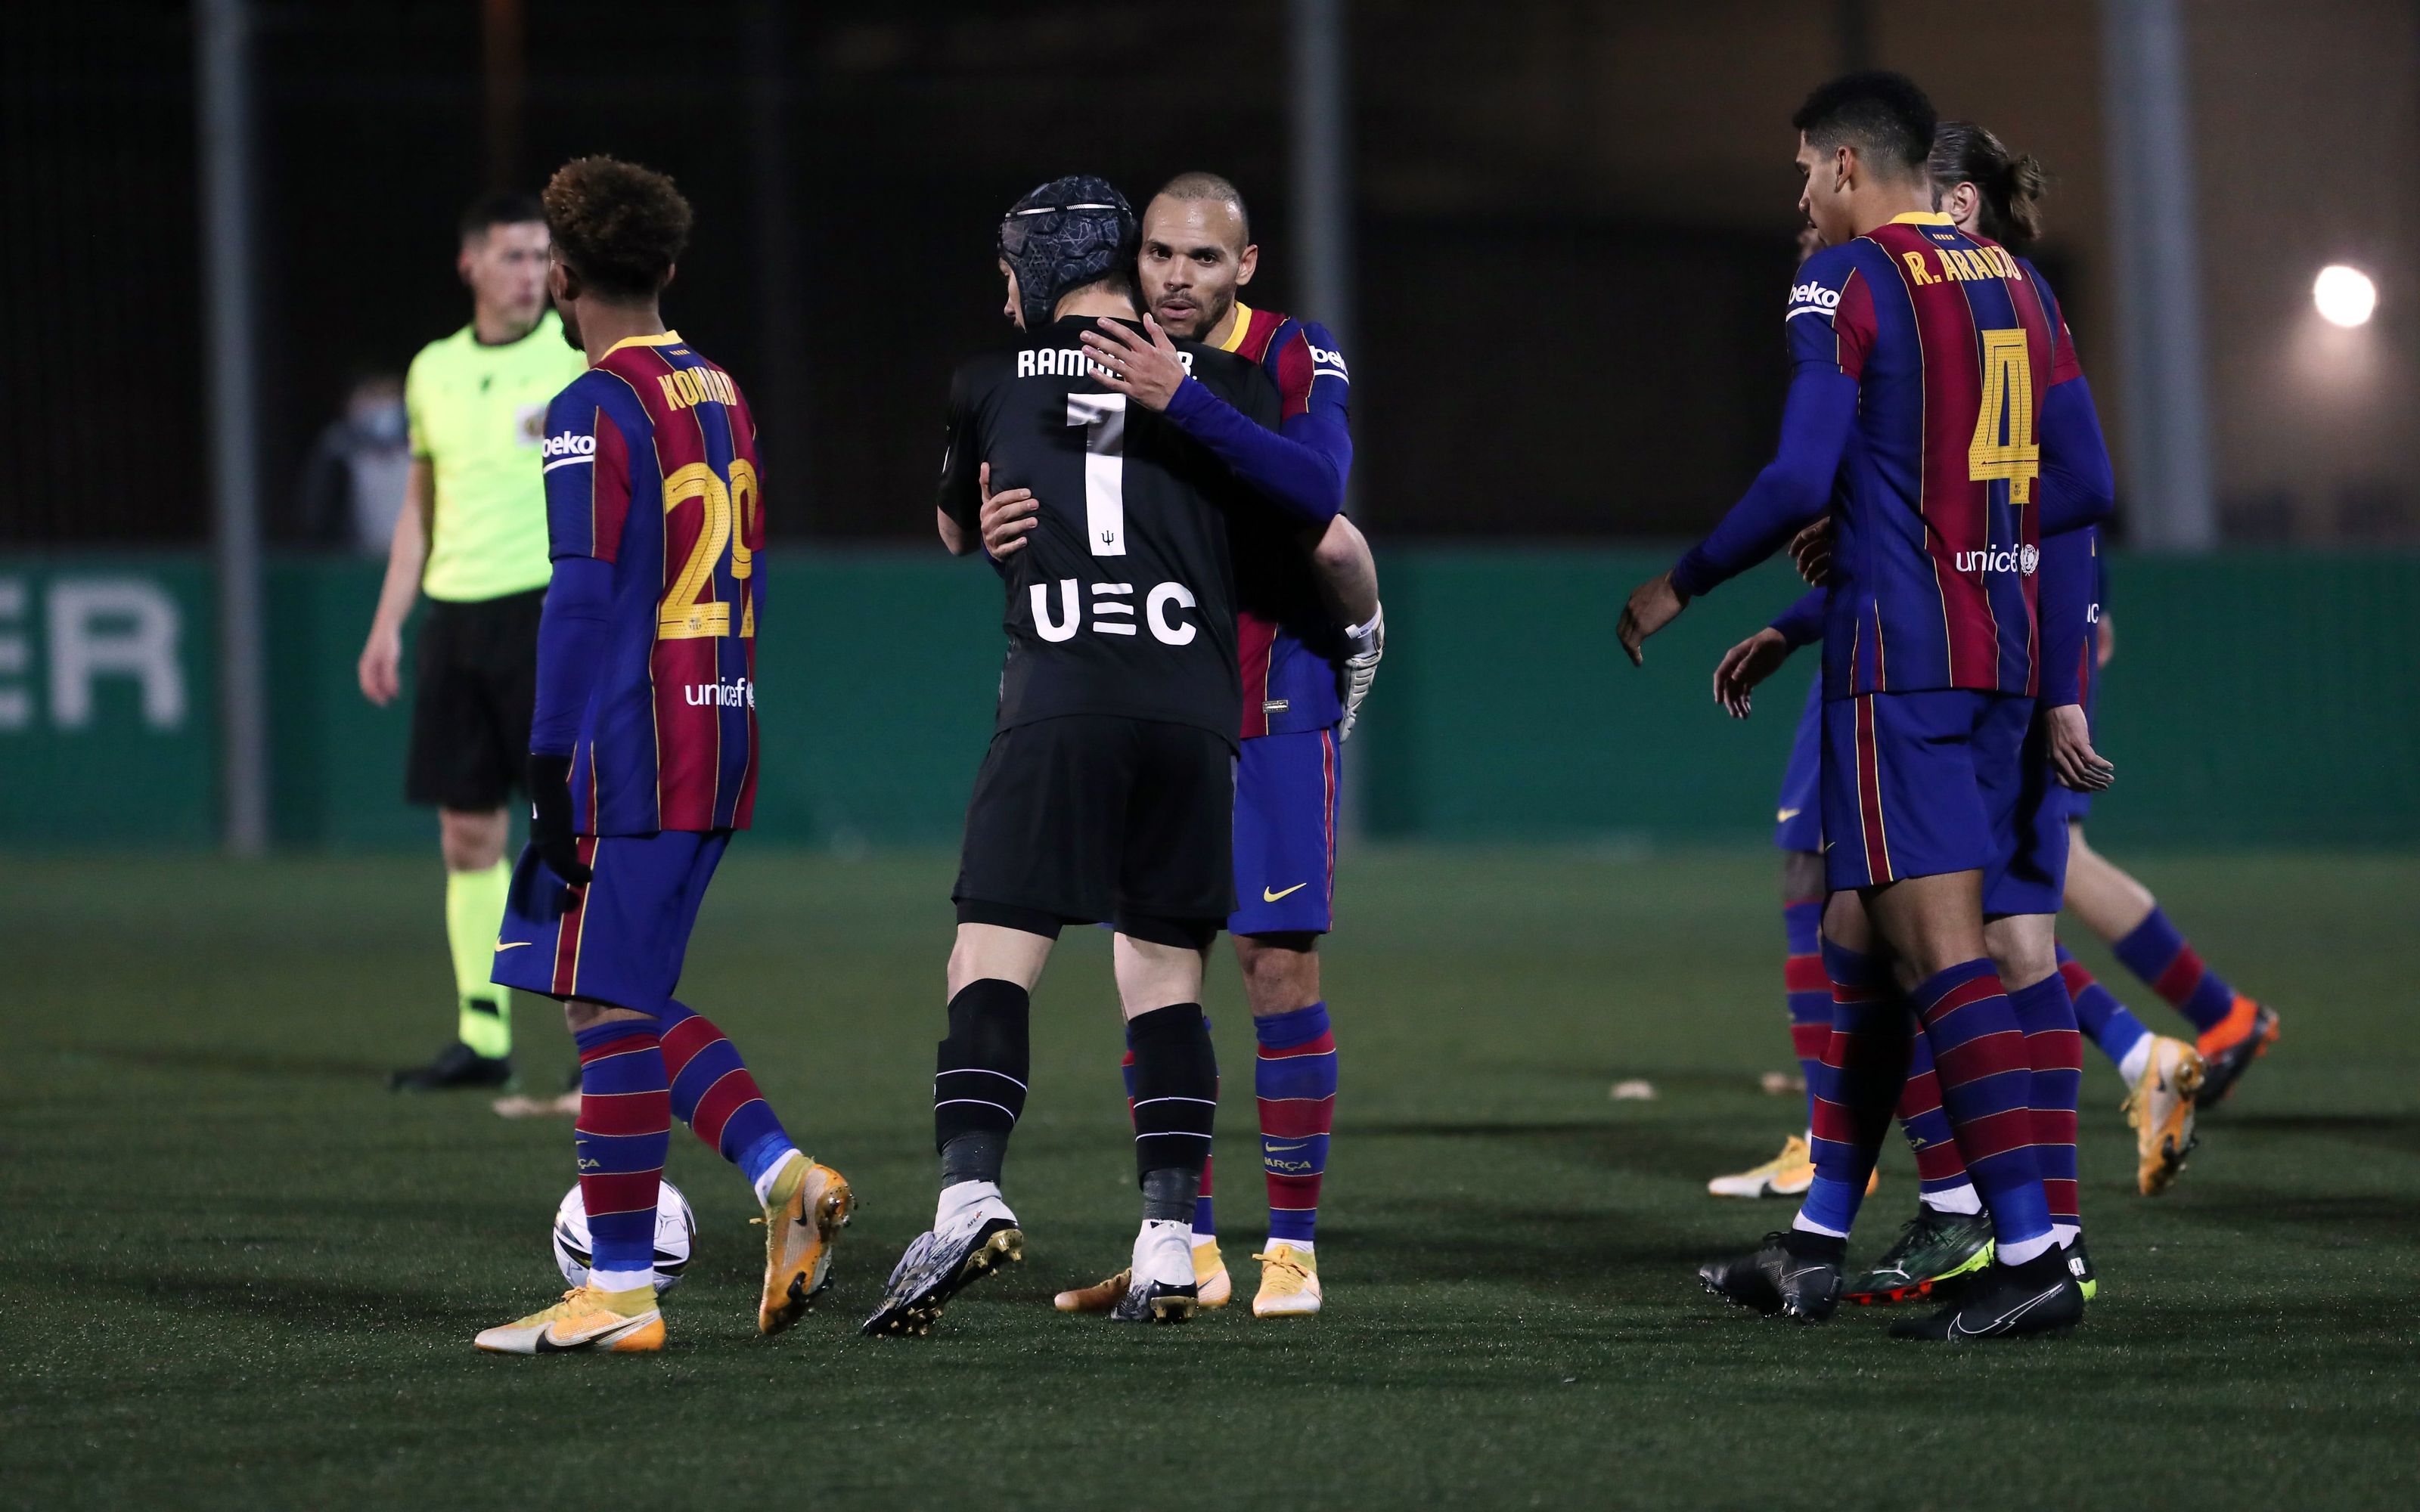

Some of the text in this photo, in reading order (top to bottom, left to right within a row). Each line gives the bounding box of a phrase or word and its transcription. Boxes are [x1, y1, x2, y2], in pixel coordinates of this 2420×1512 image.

[1788, 280, 1840, 308] beko
[656, 366, 737, 412] KONRAD
[1969, 328, 2040, 505] 4
[684, 676, 746, 708] unicef
